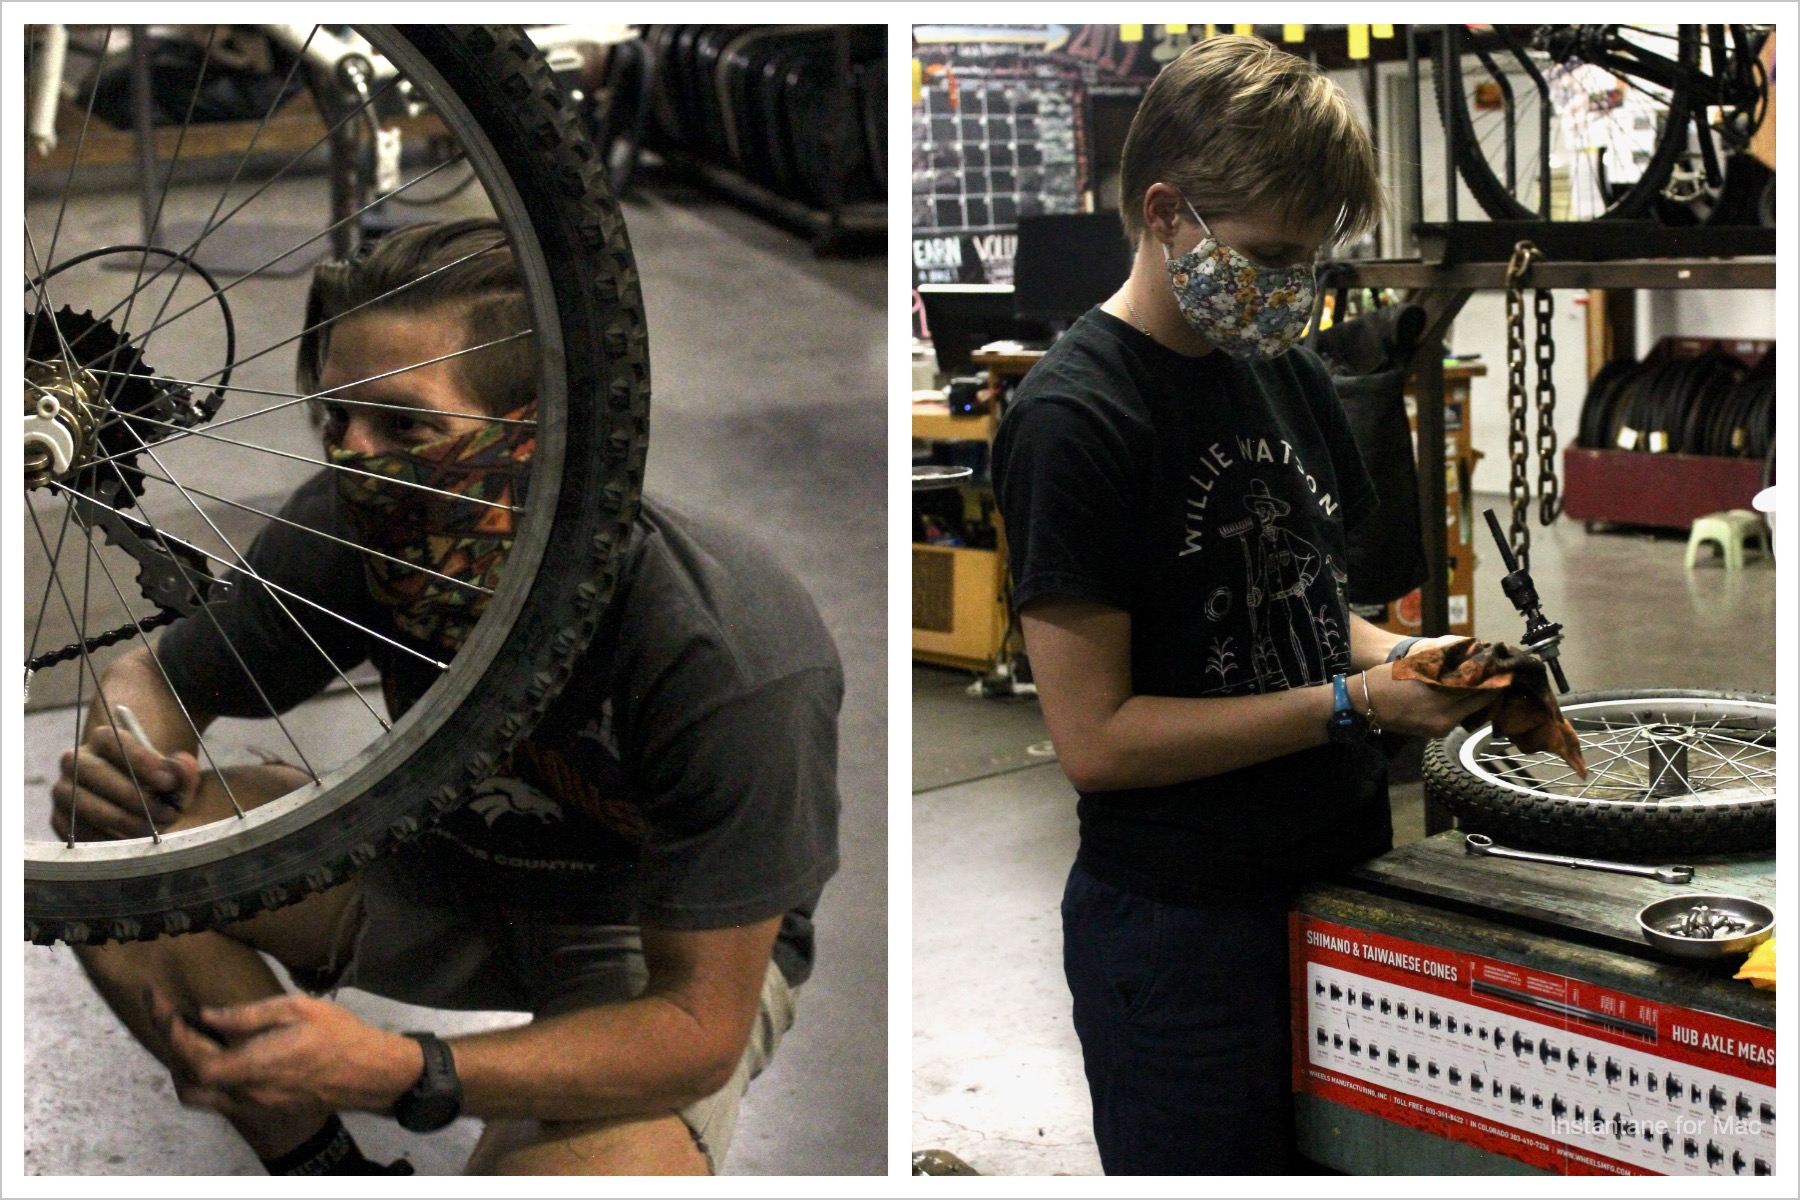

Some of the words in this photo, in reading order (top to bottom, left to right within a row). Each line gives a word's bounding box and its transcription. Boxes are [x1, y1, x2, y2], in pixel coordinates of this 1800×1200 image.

[1178, 442, 1234, 557] WILLIE
[1306, 930, 1351, 955] SHIMANO
[1352, 942, 1360, 957] &
[1362, 944, 1421, 973] TAIWANESE
[1423, 959, 1458, 982] CONES
[1672, 1024, 1699, 1046] HUB
[1701, 1032, 1734, 1055] AXLE
[1738, 1041, 1775, 1066] MEAS
[1308, 1069, 1331, 1083] WHEELS
[1377, 1092, 1388, 1101] INC
[1393, 1097, 1408, 1107] TOLL
[1477, 1122, 1509, 1138] COLORADO
